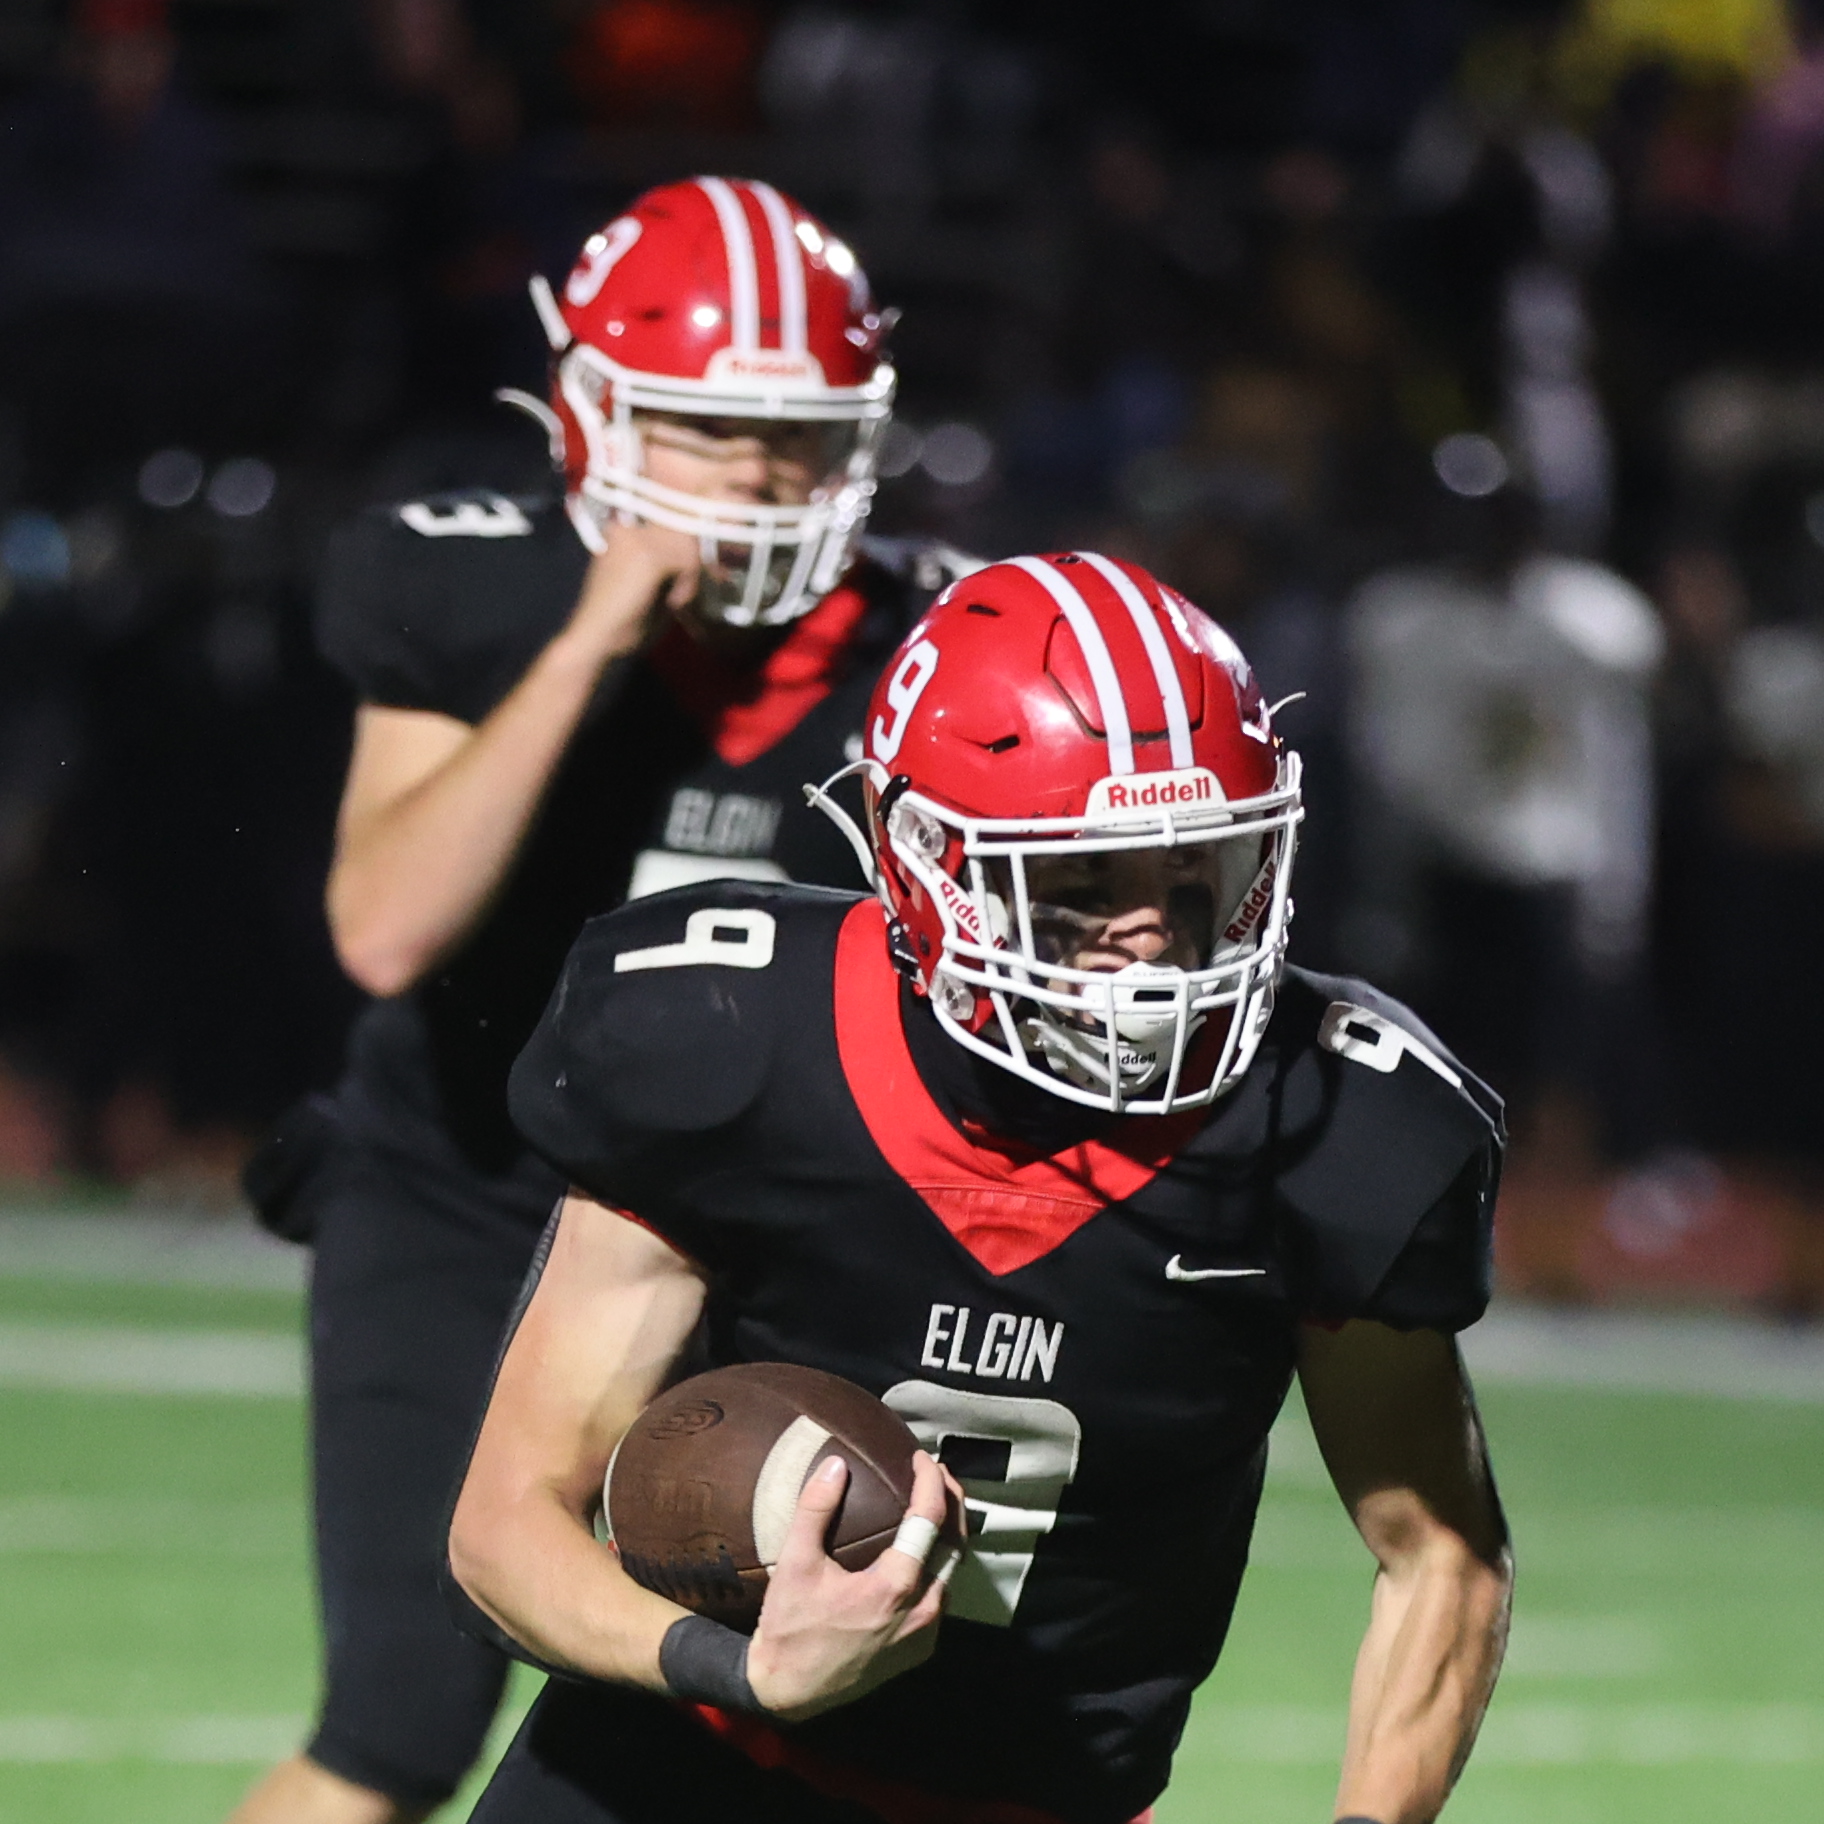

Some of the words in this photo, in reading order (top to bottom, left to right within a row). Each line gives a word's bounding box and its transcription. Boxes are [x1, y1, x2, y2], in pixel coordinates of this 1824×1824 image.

[873, 639, 939, 764] 9
[1108, 777, 1211, 809] Riddell
[614, 908, 776, 973] 9
[1317, 1001, 1463, 1073] 9
[921, 1303, 1064, 1383] ELGIN
[881, 1379, 1082, 1628] 9
